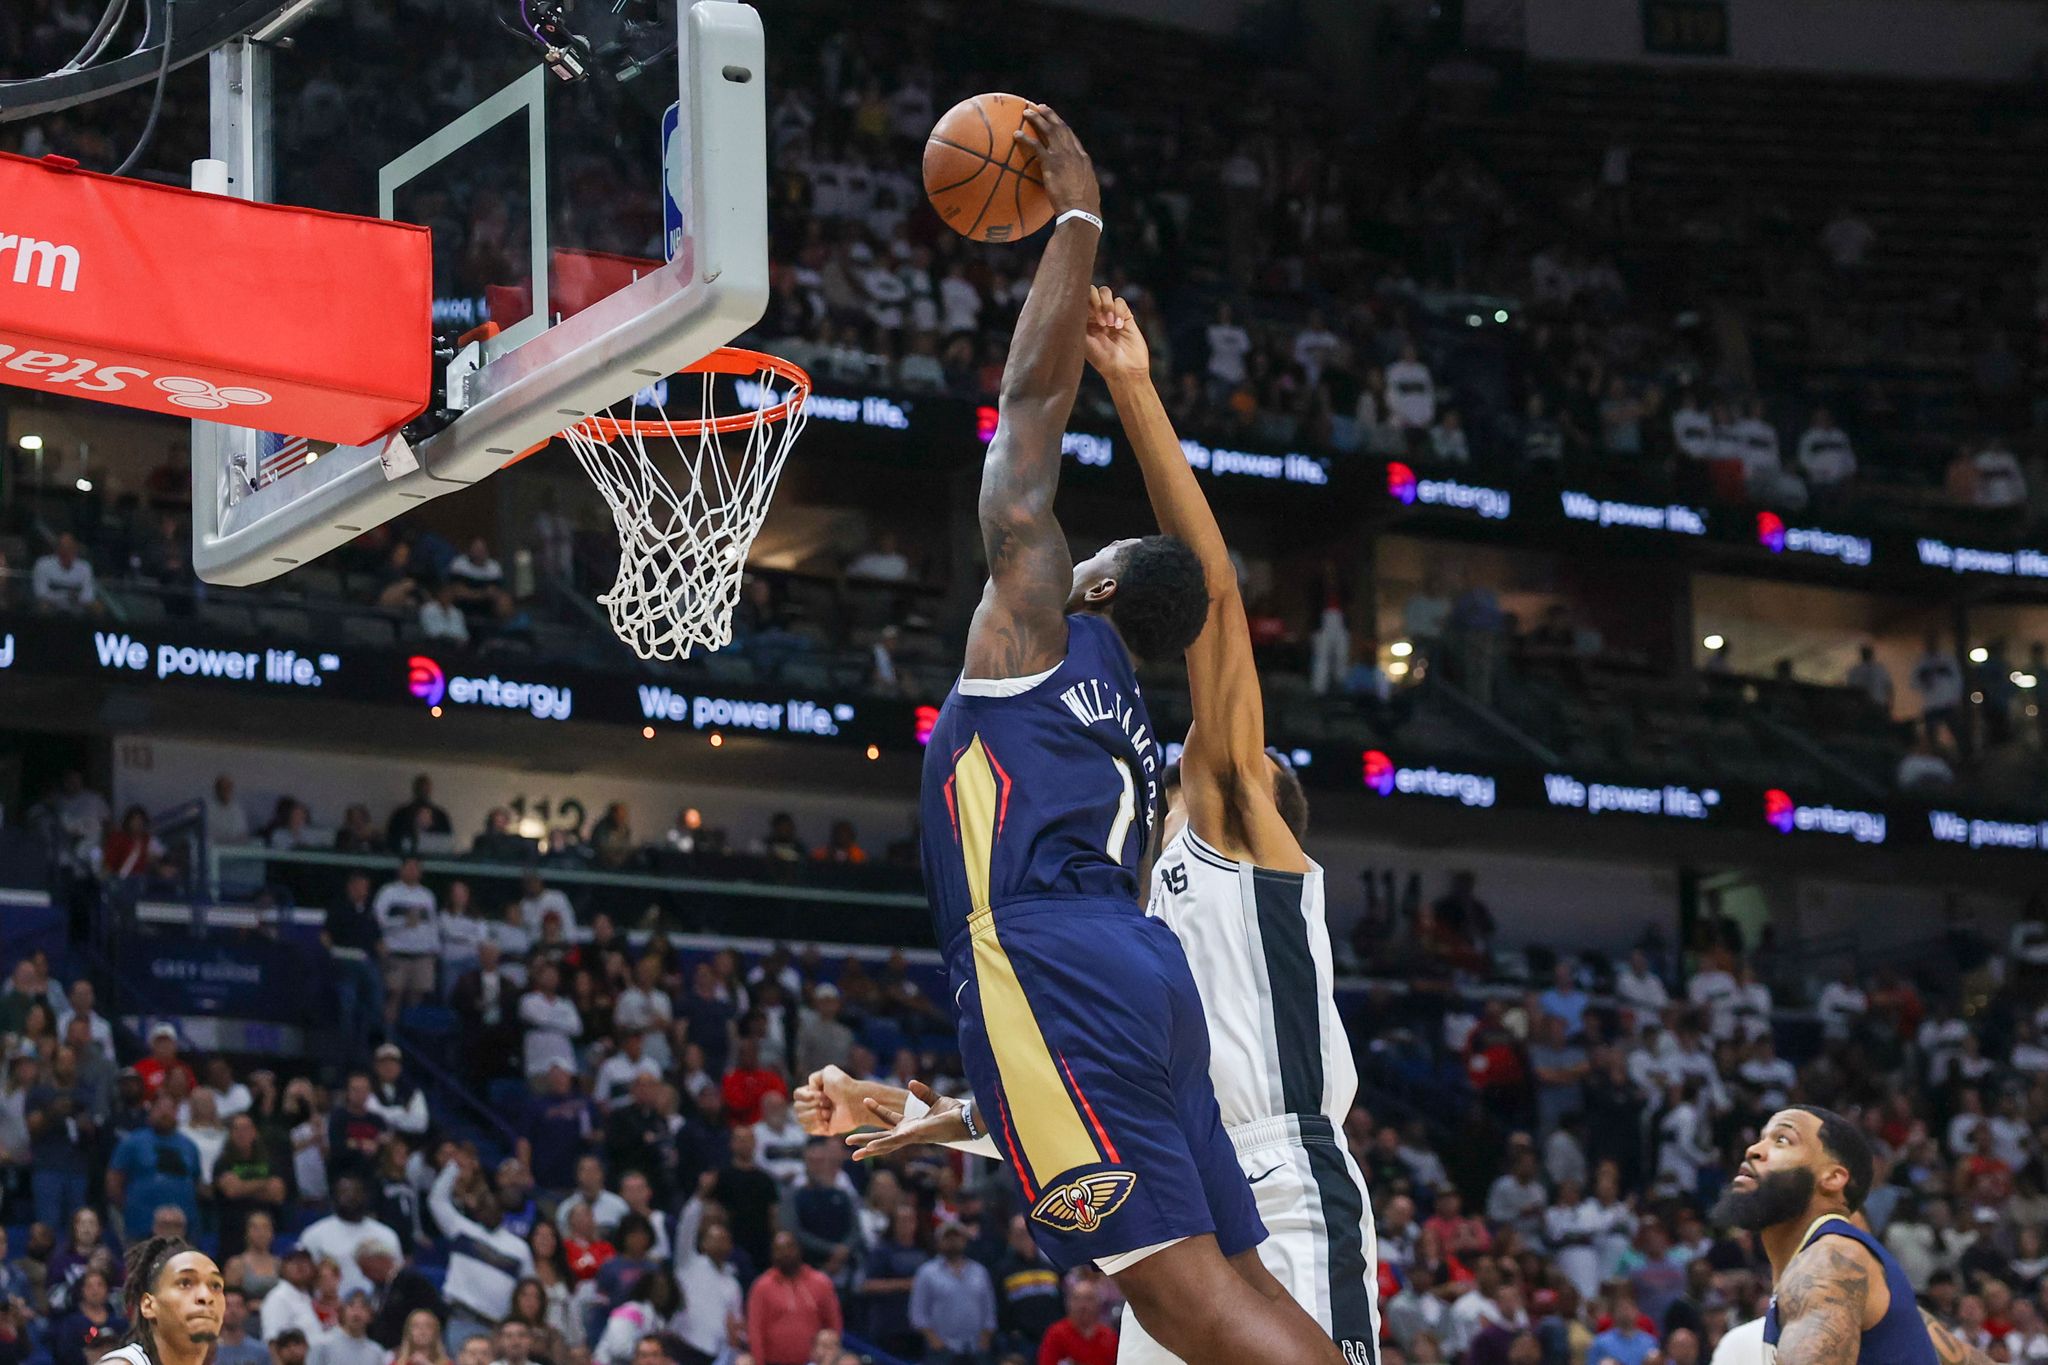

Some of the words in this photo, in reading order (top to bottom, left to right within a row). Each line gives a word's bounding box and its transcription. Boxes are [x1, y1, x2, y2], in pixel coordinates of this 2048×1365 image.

[734, 379, 779, 409] We
[1212, 449, 1283, 477] power
[1417, 480, 1510, 520] entergy
[1561, 491, 1598, 521] We
[1600, 501, 1664, 528] power
[1785, 528, 1871, 566] entergy
[95, 632, 149, 670] We
[157, 645, 260, 680] power
[448, 675, 572, 720] entergy
[638, 685, 688, 720] We
[693, 696, 783, 729] power
[1395, 766, 1495, 807] entergy
[1544, 774, 1585, 807] We
[1587, 784, 1661, 814] power
[1794, 805, 1886, 844] entergy
